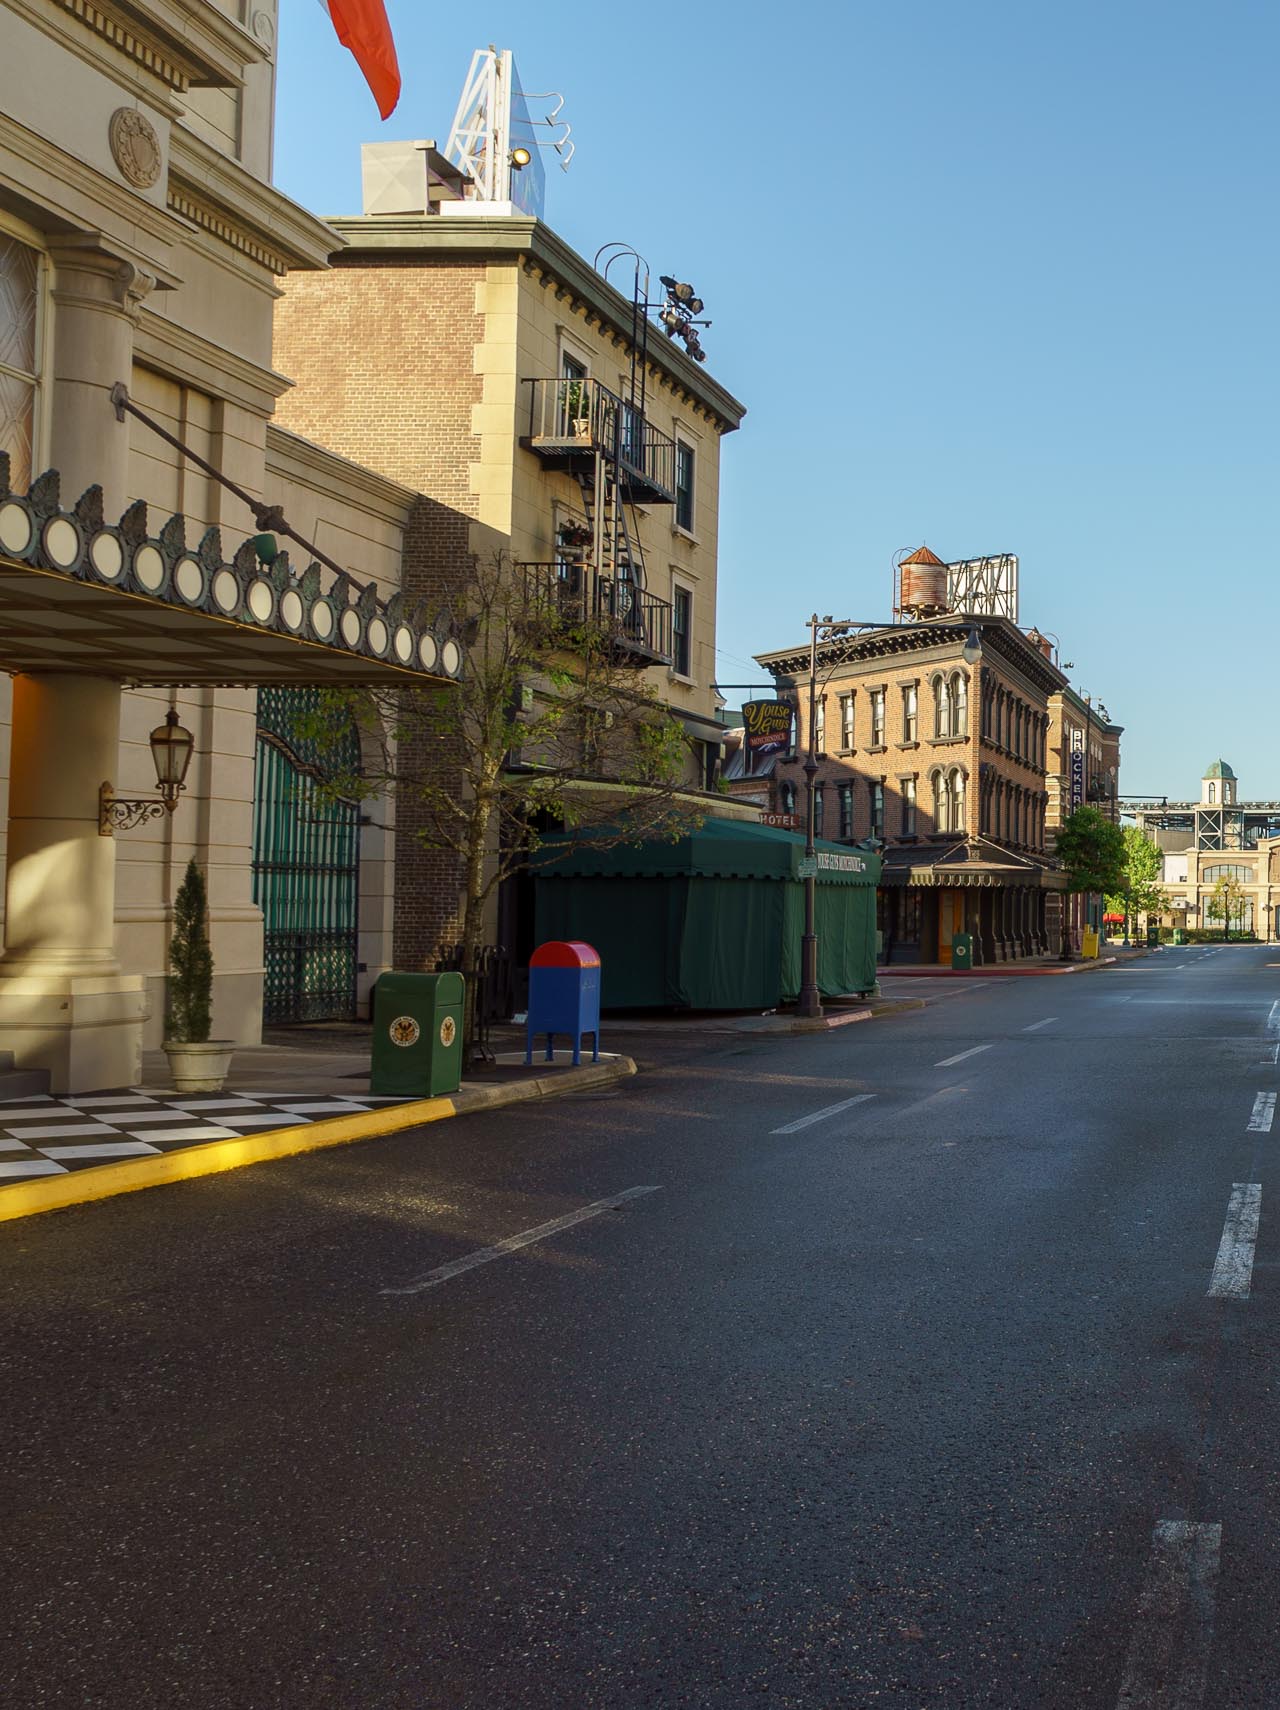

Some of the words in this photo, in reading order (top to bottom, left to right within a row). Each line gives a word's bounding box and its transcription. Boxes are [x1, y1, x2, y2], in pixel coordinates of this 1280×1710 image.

[745, 703, 790, 732] Youse
[759, 717, 790, 734] Guys
[760, 815, 797, 826] HOTEL
